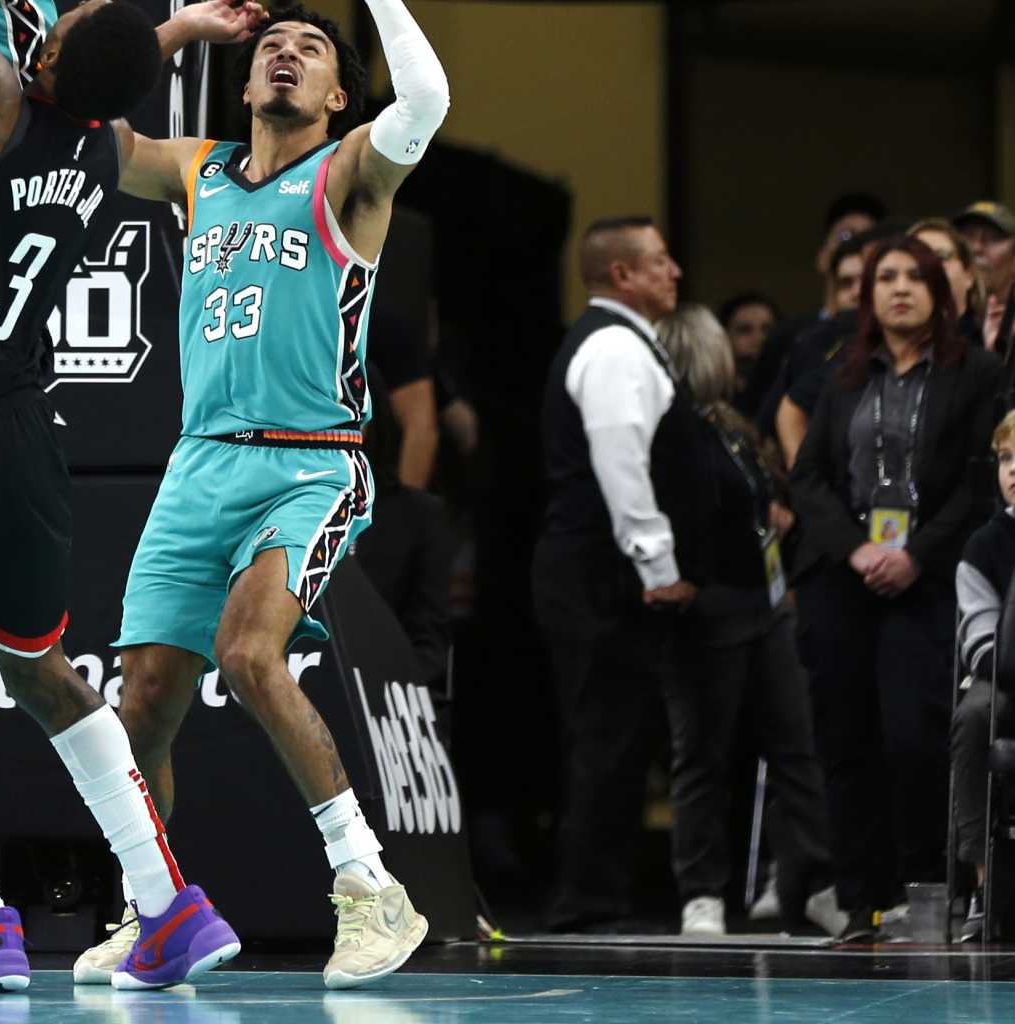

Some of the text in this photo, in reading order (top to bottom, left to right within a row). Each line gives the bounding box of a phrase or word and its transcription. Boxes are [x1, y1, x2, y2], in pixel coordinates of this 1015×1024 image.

[10, 168, 86, 212] PORTER
[203, 163, 222, 178] 6
[188, 221, 309, 280] SPURS
[202, 284, 264, 344] 33
[353, 666, 462, 835] bet365
